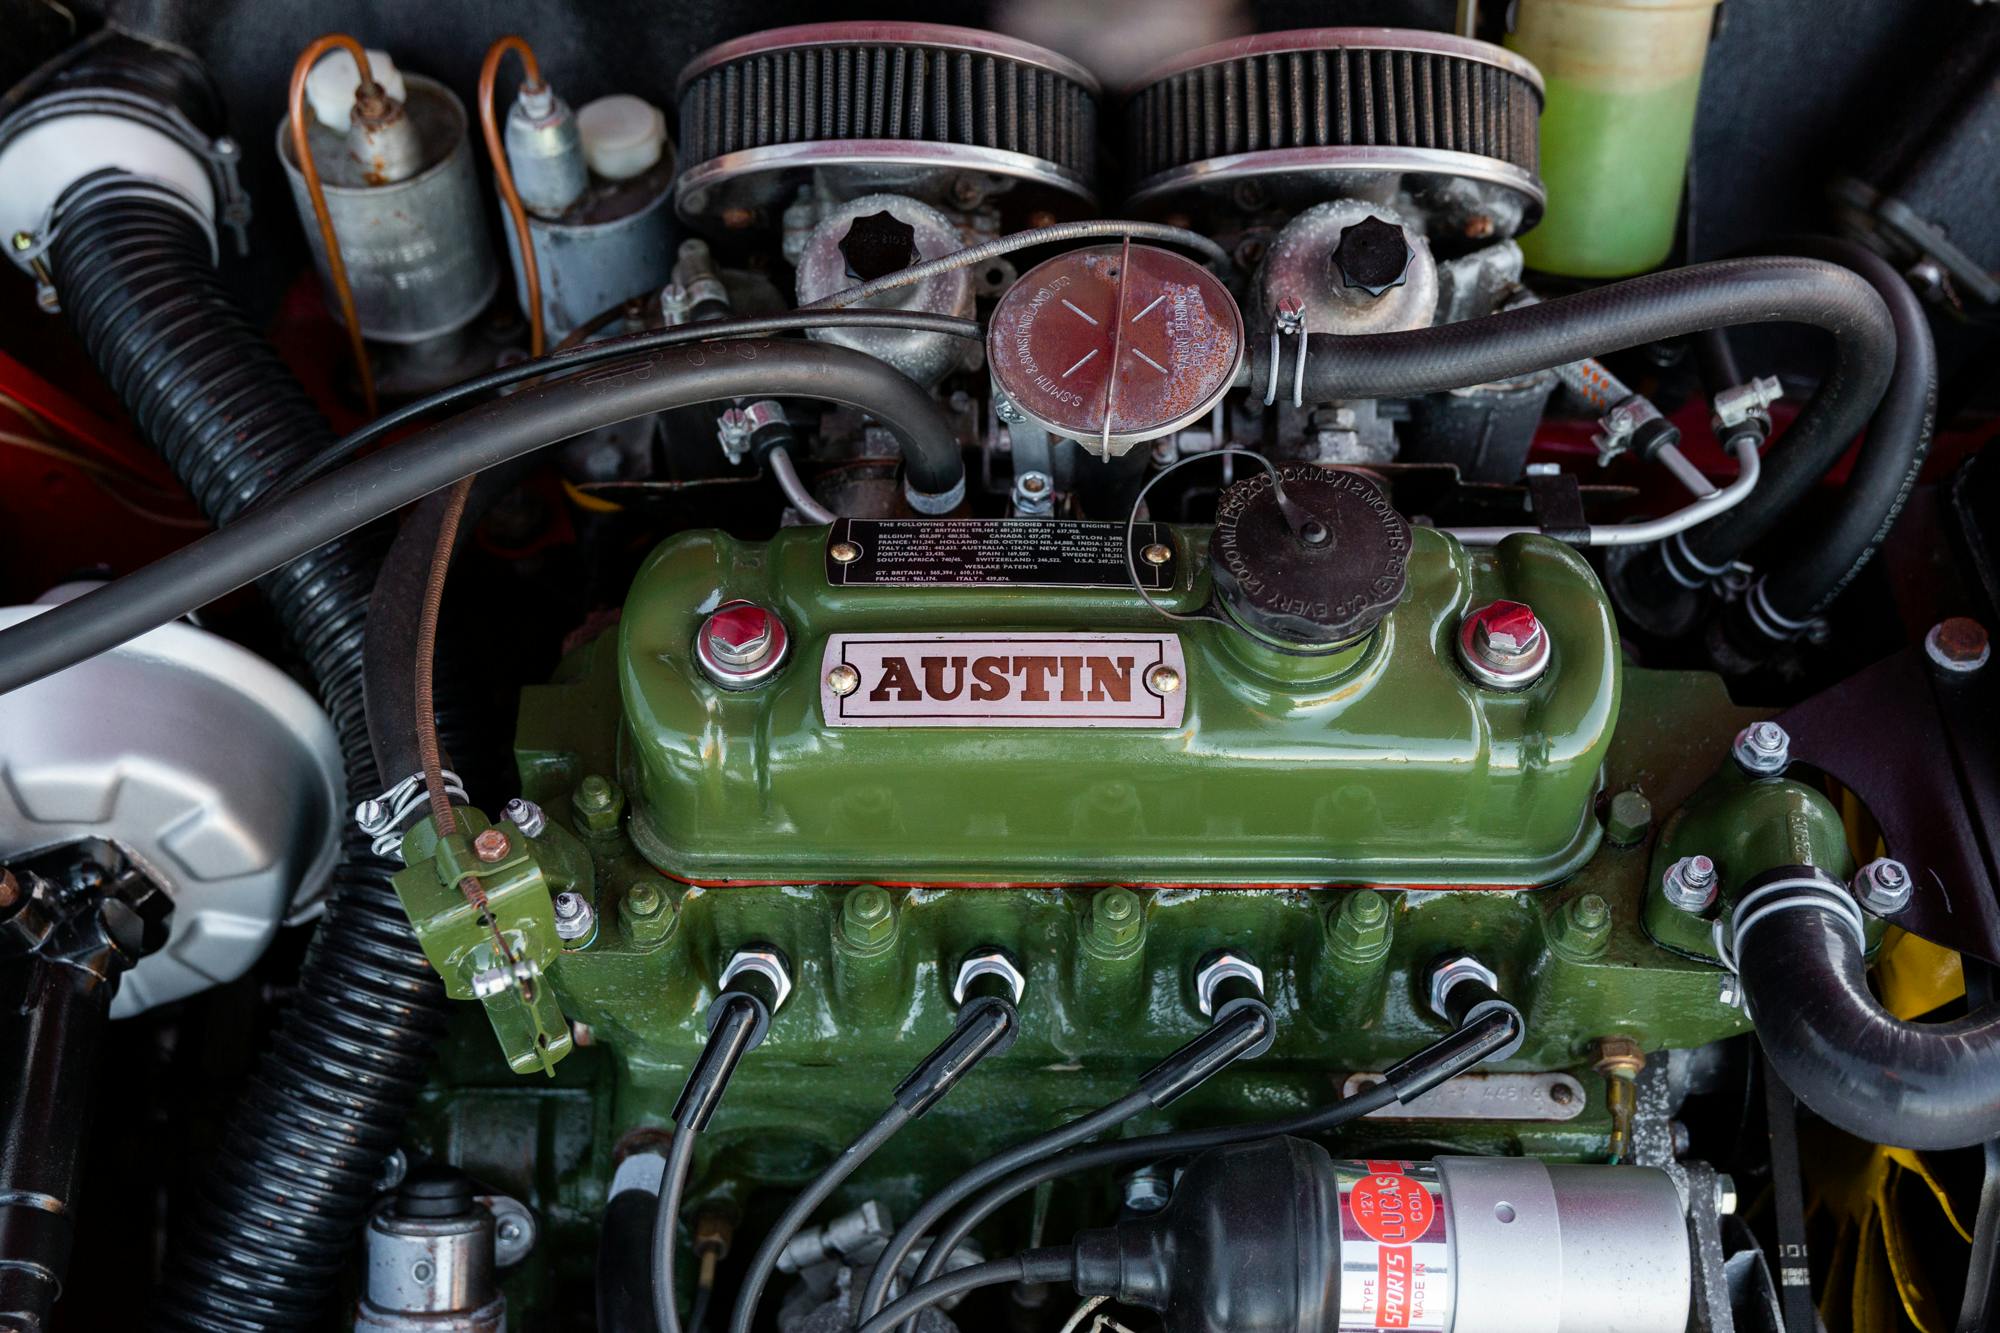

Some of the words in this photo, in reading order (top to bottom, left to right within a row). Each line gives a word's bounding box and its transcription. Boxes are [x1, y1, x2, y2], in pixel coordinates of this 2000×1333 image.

[1917, 413, 1933, 451] MAX
[1872, 459, 1922, 543] PRESSURE
[1267, 593, 1328, 618] EVERY
[870, 656, 1135, 702] AUSTIN
[1359, 1191, 1374, 1217] 12V
[1375, 1176, 1406, 1239] LUCAS
[1408, 1188, 1424, 1223] COIL
[1384, 1252, 1405, 1325] SPORTS
[1415, 1263, 1426, 1277] IN
[1363, 1279, 1375, 1313] TYPE
[1412, 1281, 1425, 1319] MADE
